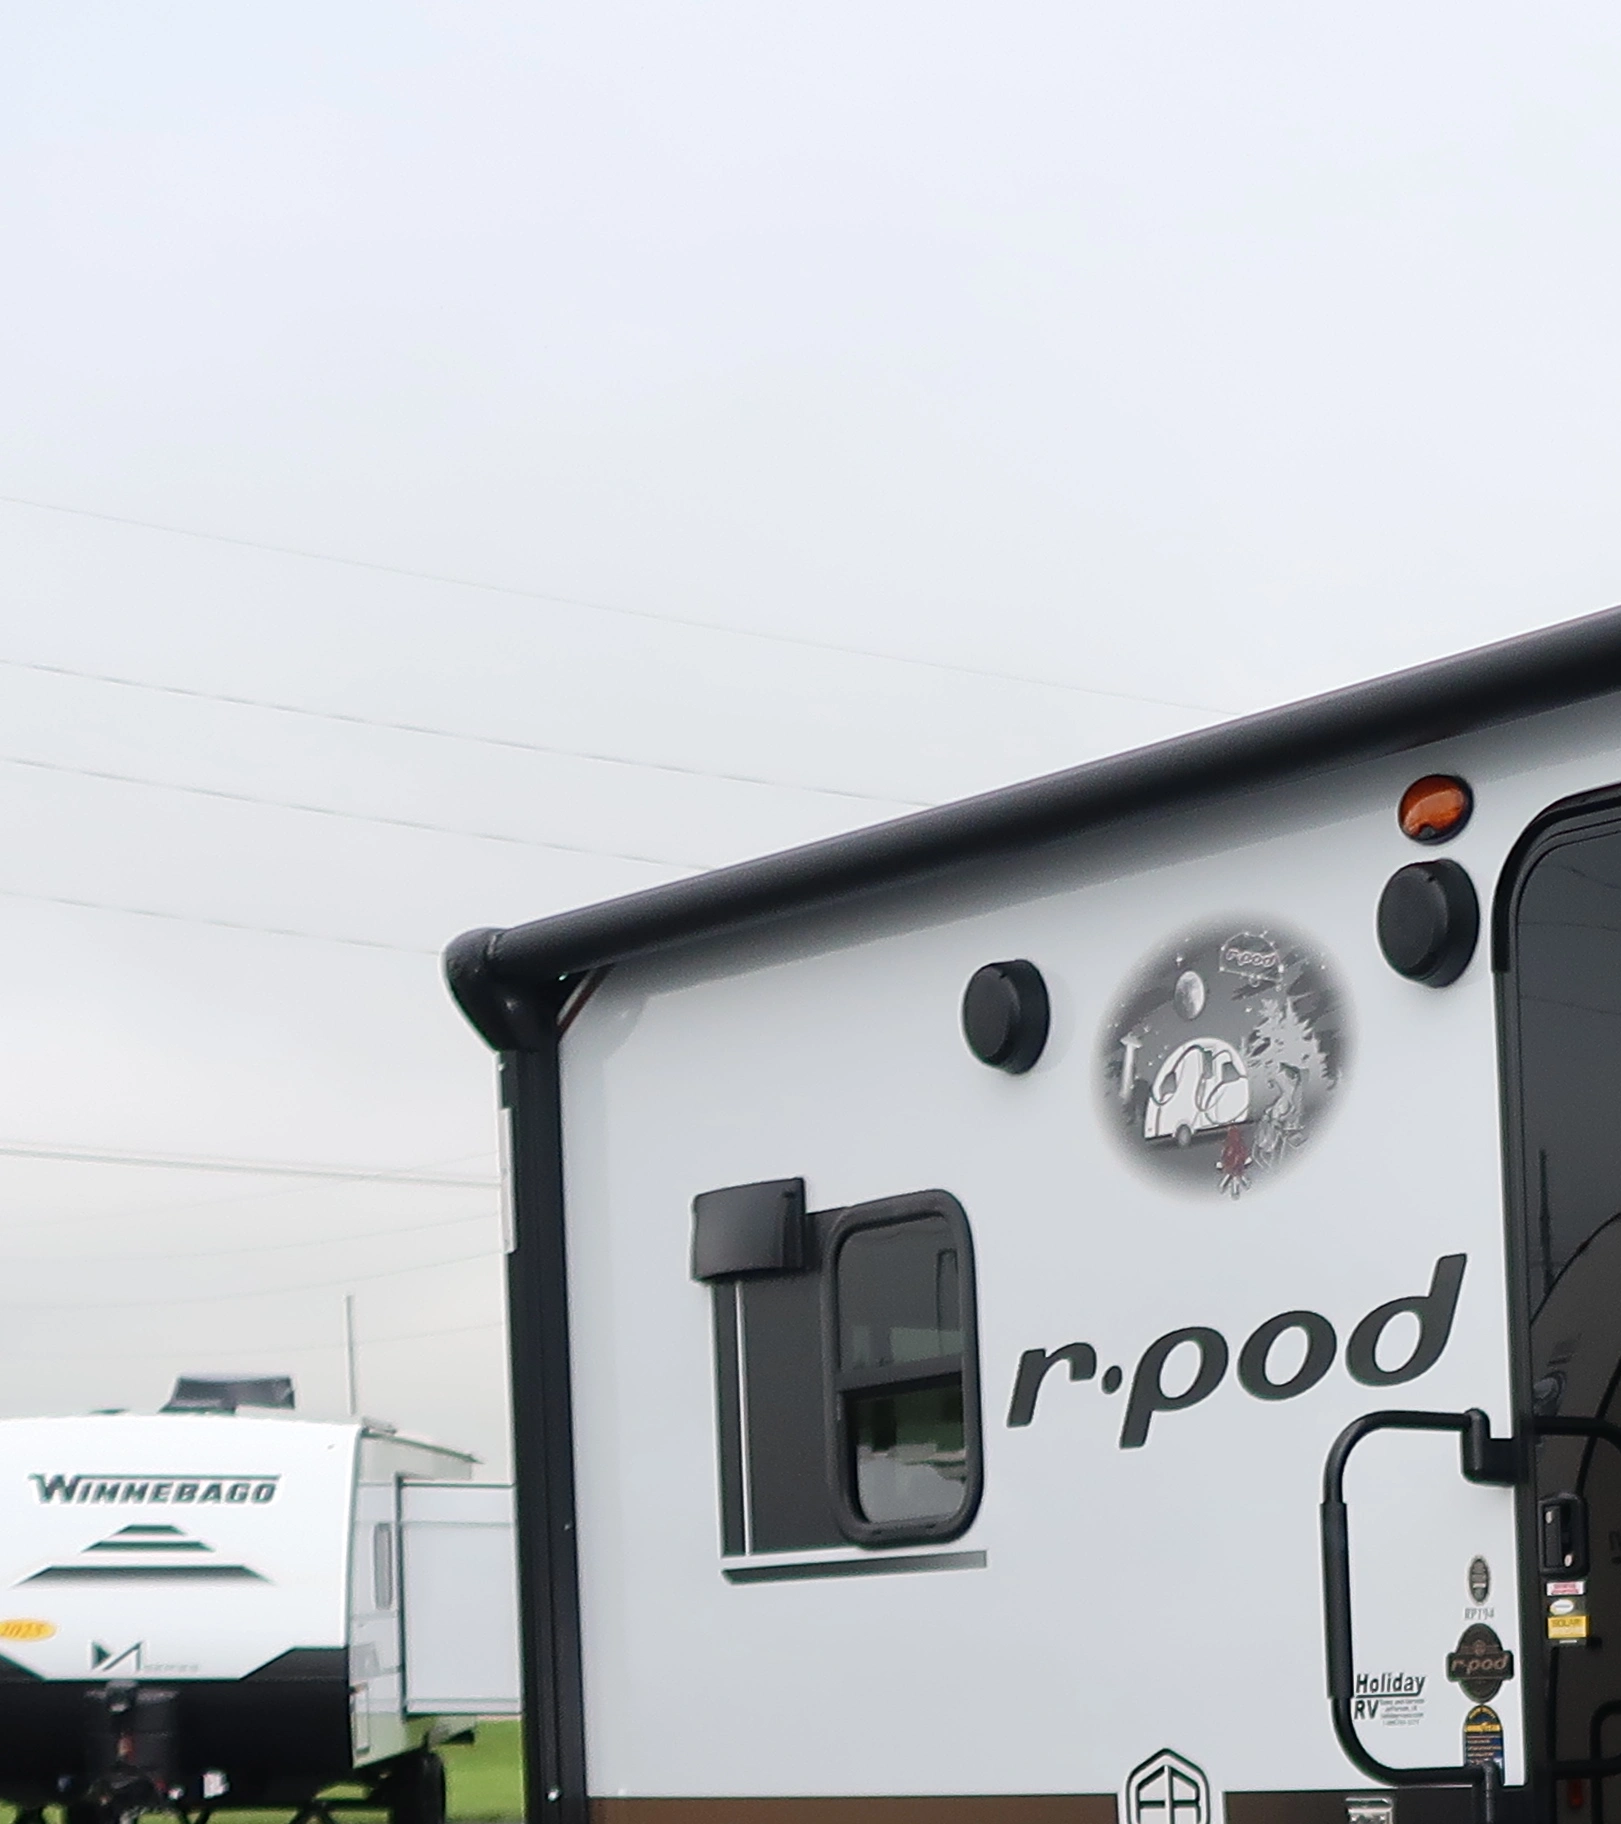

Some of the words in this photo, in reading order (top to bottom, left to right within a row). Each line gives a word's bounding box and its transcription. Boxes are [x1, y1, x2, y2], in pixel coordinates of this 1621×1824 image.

[28, 1473, 281, 1504] WINNEBAGO
[1355, 1672, 1426, 1697] Holiday
[1353, 1699, 1380, 1721] RV
